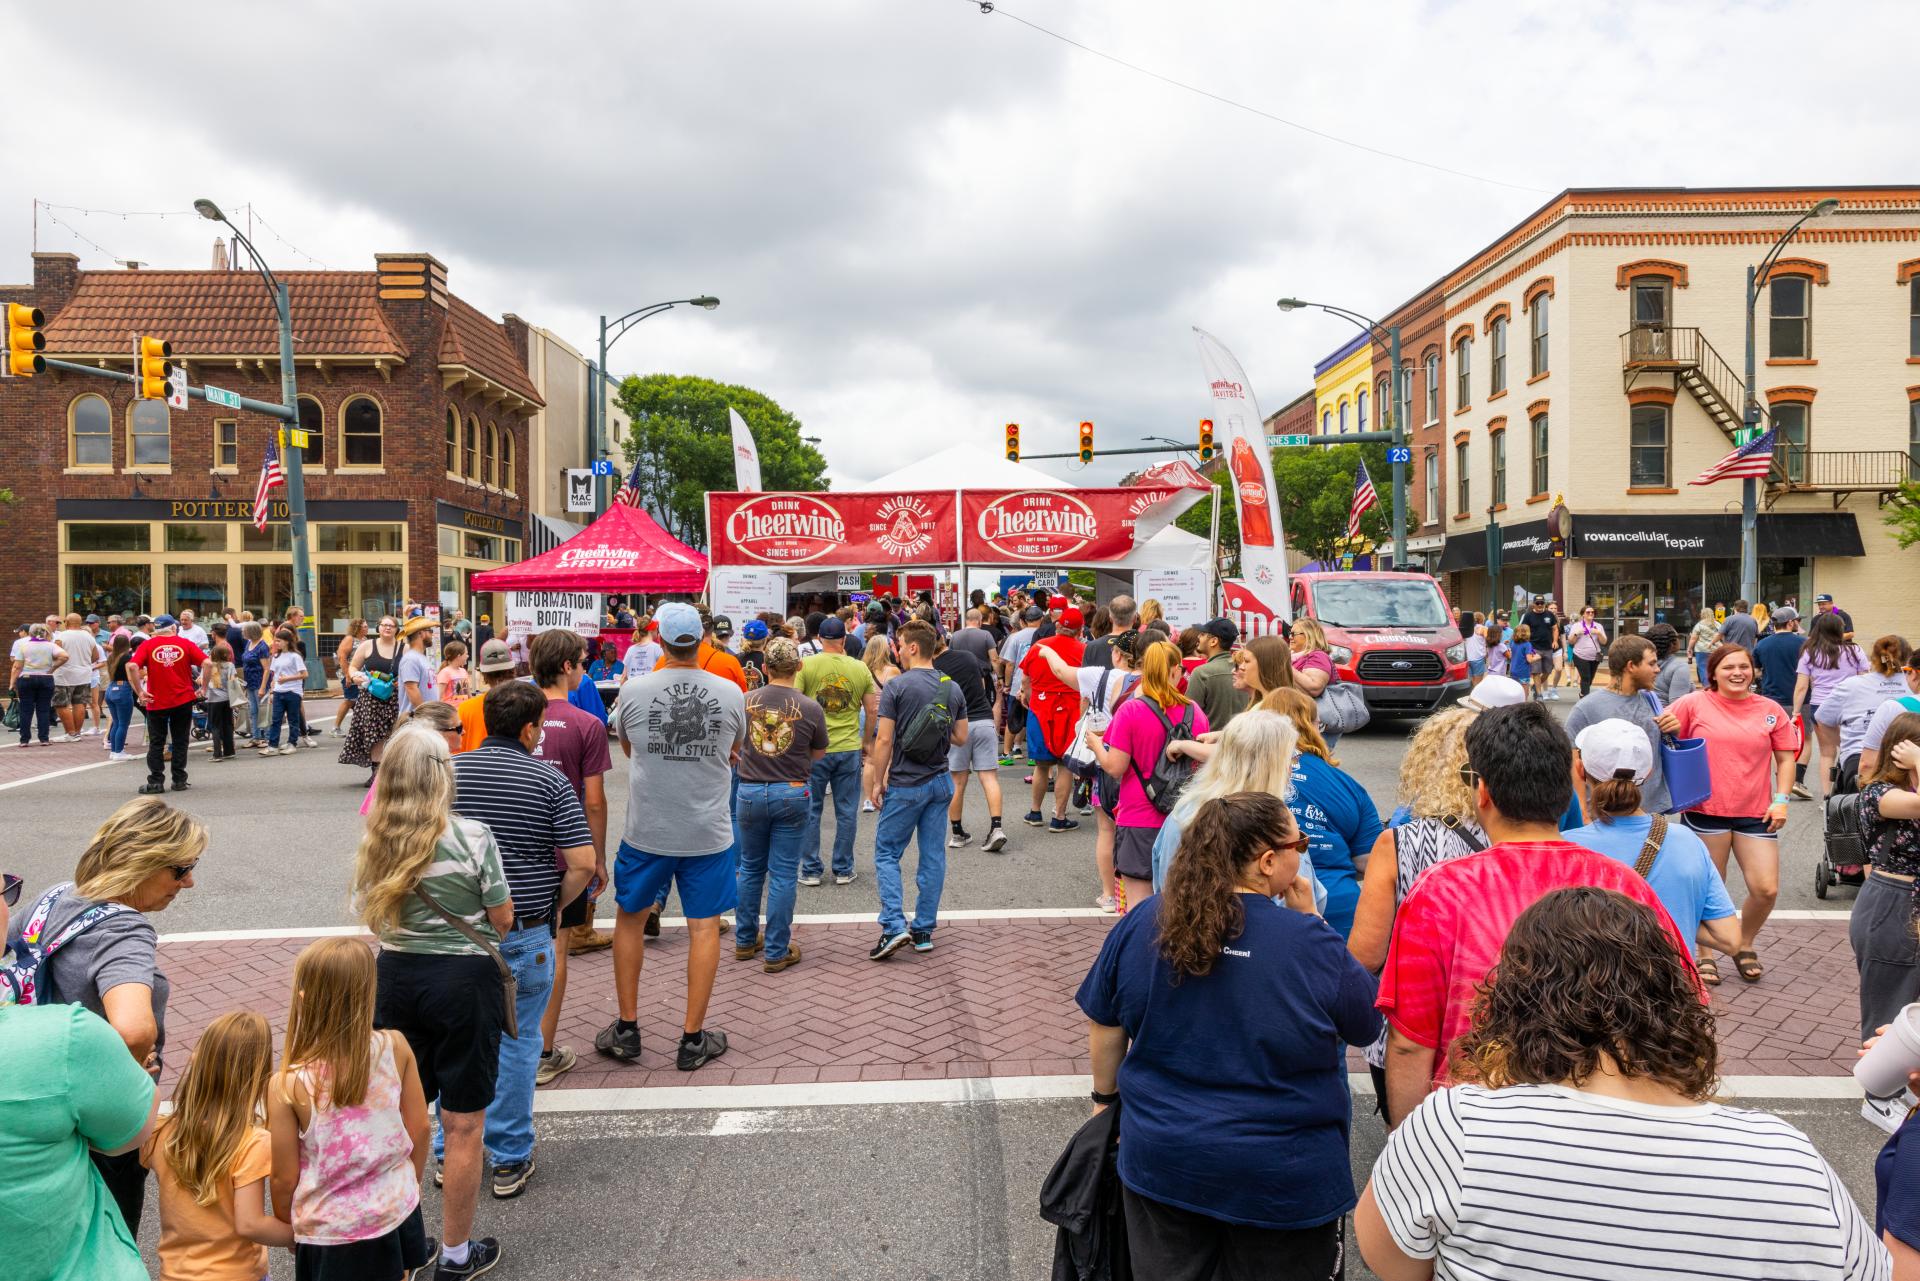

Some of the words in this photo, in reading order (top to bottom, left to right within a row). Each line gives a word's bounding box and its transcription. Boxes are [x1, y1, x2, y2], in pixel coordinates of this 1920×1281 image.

[208, 388, 226, 402] MAIN
[230, 393, 239, 406] ST
[1266, 435, 1290, 445] NNES
[1296, 434, 1305, 444] ST
[1392, 448, 1408, 462] 2S
[595, 461, 608, 475] 1S
[771, 500, 800, 510] DRINK
[876, 496, 932, 518] UNIQUELY
[1023, 497, 1052, 506] DRINK
[272, 502, 290, 518] 10
[726, 508, 845, 544] Cheerwine
[869, 523, 887, 531] SINCE
[920, 522, 936, 530] 1917
[978, 504, 1096, 540] Cheerwine
[876, 533, 932, 558] SOUTHERN
[1532, 538, 1552, 554] repair
[1584, 531, 1668, 542] rowancellular
[1664, 536, 1704, 550] repair
[561, 548, 639, 561] Cheerwine
[766, 548, 788, 557] SINCE
[790, 548, 807, 557] 1917
[1018, 544, 1040, 553] SINCE
[1042, 544, 1058, 552] 1917
[570, 559, 635, 568] FESTIVAL
[838, 576, 860, 586] CASH
[515, 591, 593, 610] INFORMATION
[537, 610, 572, 626] BOOTH
[1364, 633, 1428, 644] Cheerwine
[664, 682, 708, 700] TREAD
[707, 698, 722, 715] ON
[648, 697, 666, 732] DON'T
[543, 720, 567, 728] DRINK.
[708, 720, 722, 735] ME
[647, 742, 680, 756] GRUNT
[685, 744, 718, 757] STYLE
